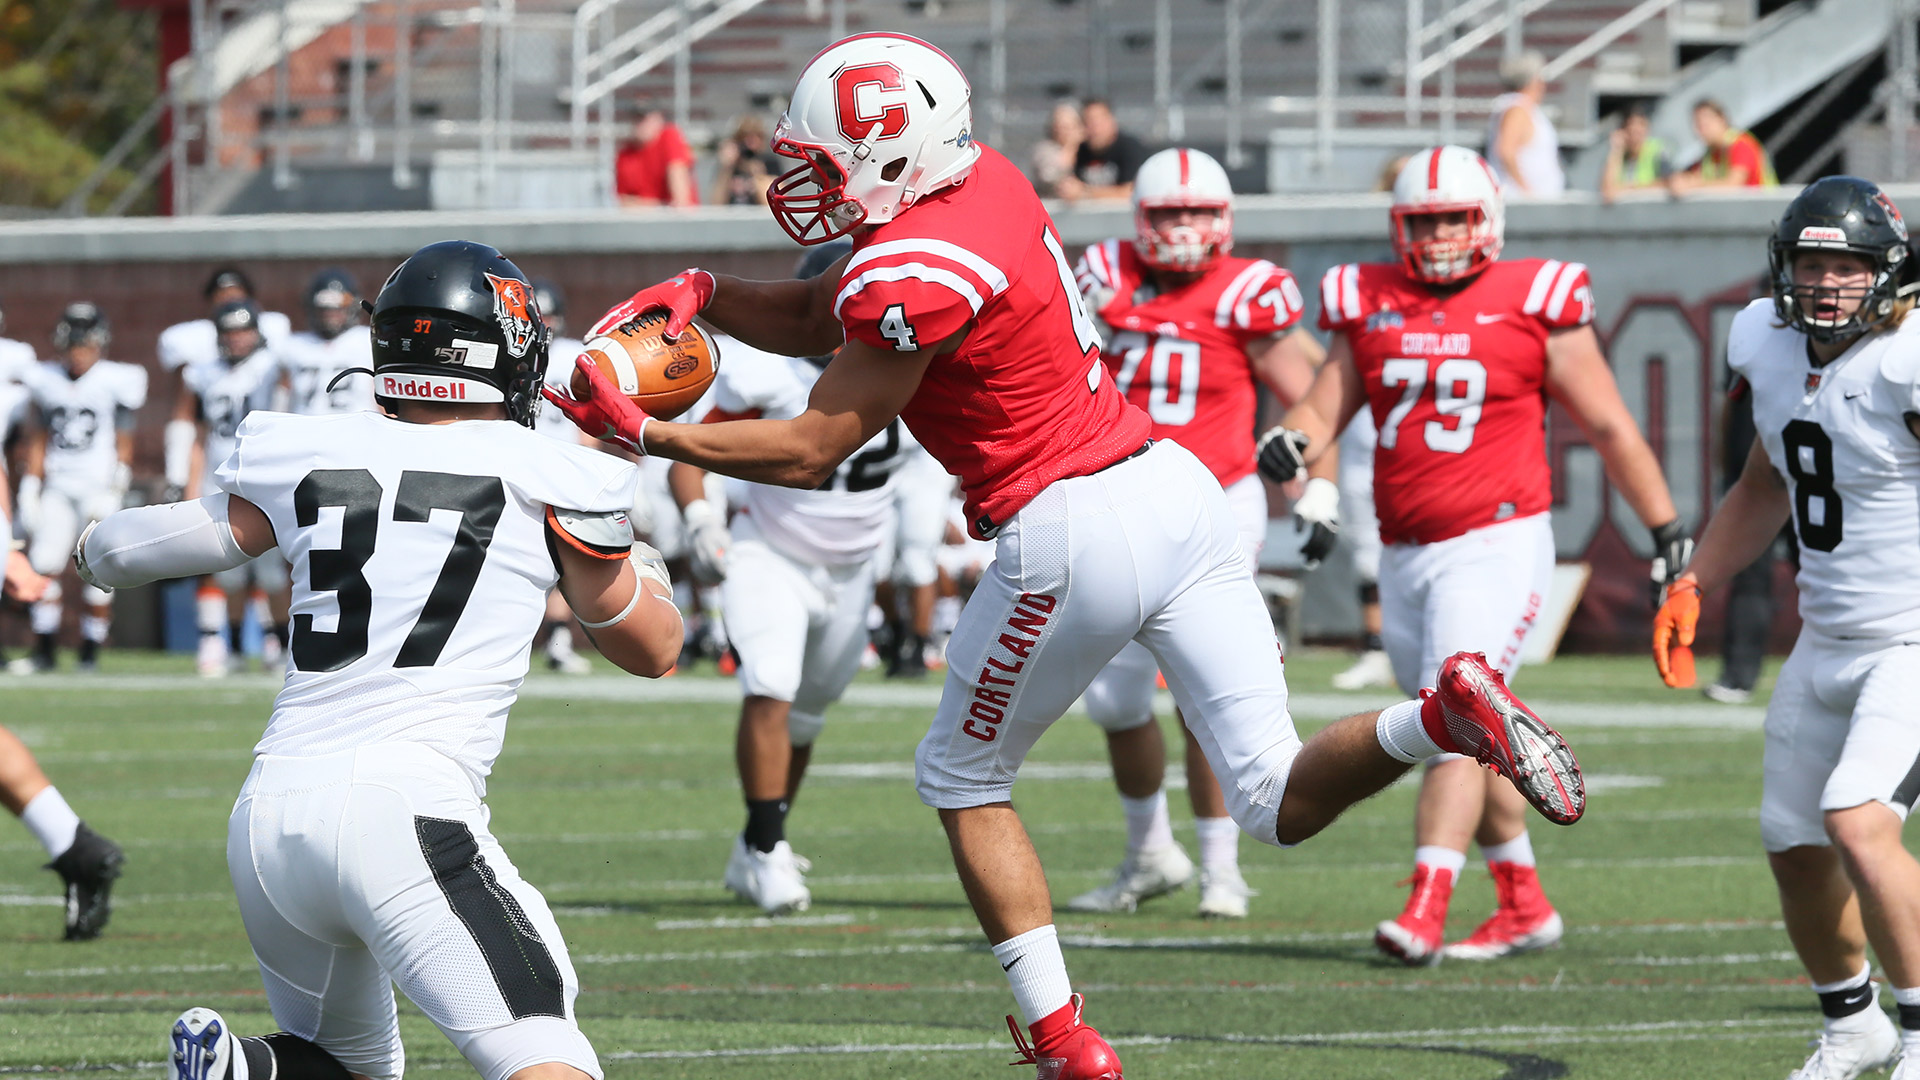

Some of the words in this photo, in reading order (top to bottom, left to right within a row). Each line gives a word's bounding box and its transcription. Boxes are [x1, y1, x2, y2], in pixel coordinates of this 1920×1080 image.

[833, 61, 909, 144] C
[414, 319, 432, 333] 37
[878, 303, 920, 351] 4
[1258, 277, 1303, 325] 70
[434, 347, 467, 364] 150
[1109, 334, 1200, 425] 70
[1401, 333, 1471, 355] CORTLAND
[384, 377, 465, 399] Riddell
[1379, 358, 1487, 453] 79
[817, 418, 899, 492] 2
[1781, 418, 1843, 553] 8
[292, 469, 506, 672] 37
[962, 592, 1057, 742] CORTLAND
